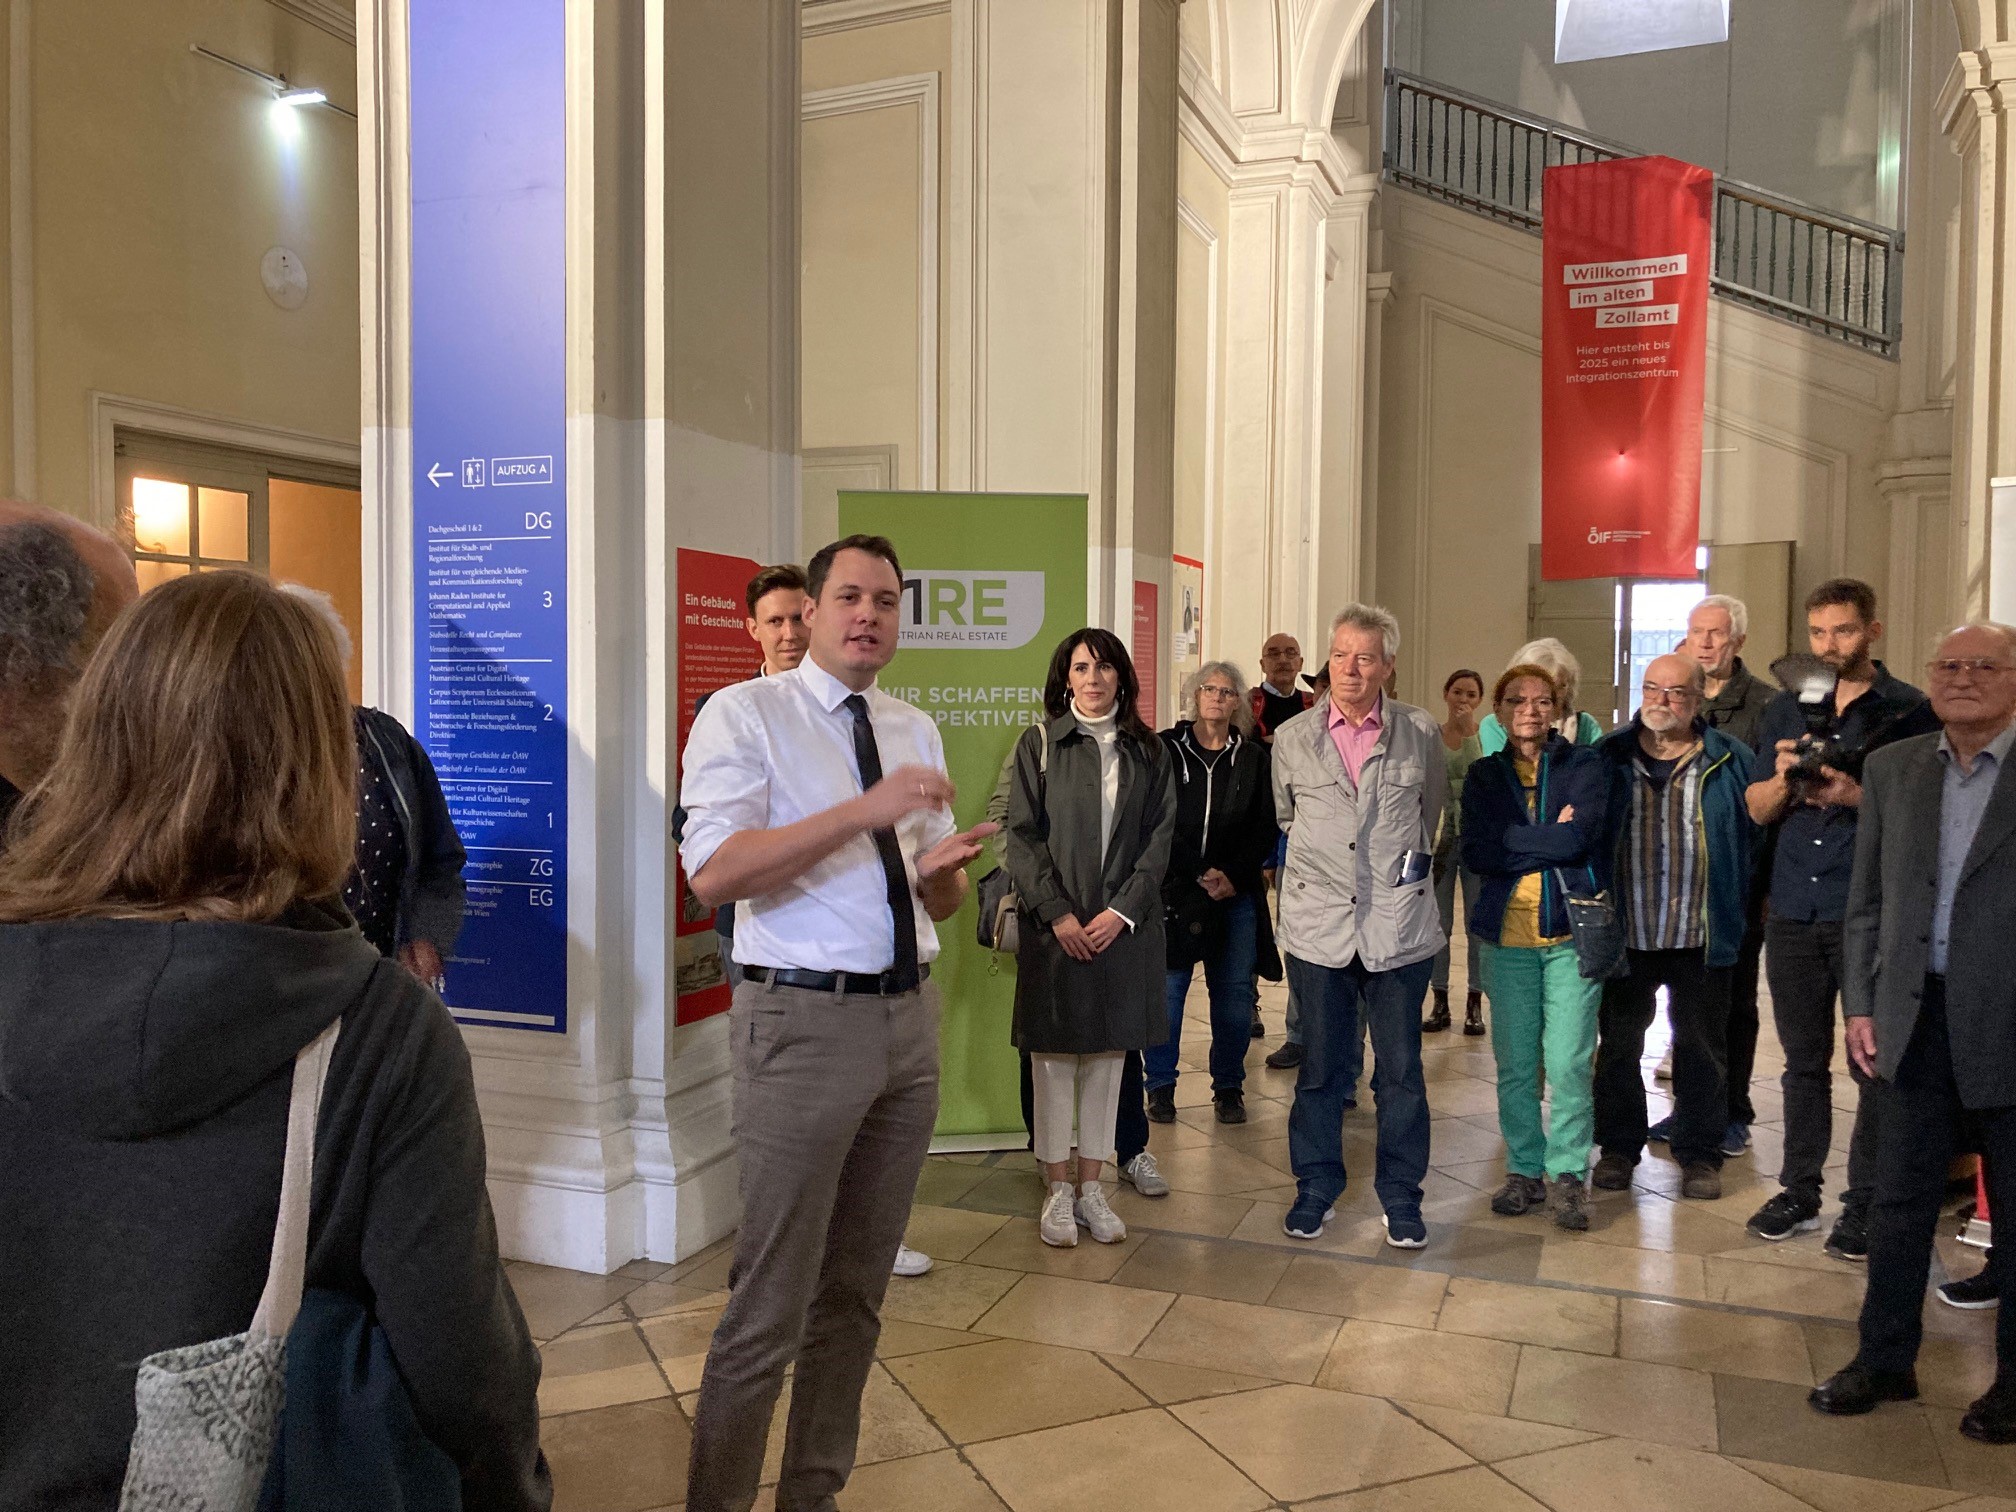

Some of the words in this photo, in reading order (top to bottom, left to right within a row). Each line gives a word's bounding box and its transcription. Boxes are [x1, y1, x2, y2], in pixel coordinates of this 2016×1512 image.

[1572, 260, 1678, 280] Willkommen
[1578, 293, 1598, 304] im
[1604, 288, 1646, 301] alten
[1604, 309, 1670, 324] Zollamt
[1577, 346, 1599, 356] Hier
[1602, 343, 1650, 354] entsteht
[1653, 340, 1670, 350] bis
[1580, 360, 1608, 369] 2025
[1612, 358, 1628, 366] ein
[1632, 356, 1666, 365] neues
[1566, 369, 1678, 384] Integrationszentrum
[497, 465, 536, 476] AUFZUG
[540, 464, 547, 474] A
[525, 511, 552, 530] DG
[429, 554, 483, 563] Regionalforschung
[462, 568, 502, 577] vergleichende
[442, 577, 522, 586] Kommunikationsforschung
[543, 590, 552, 608] 3
[685, 594, 698, 606] Ein
[701, 595, 736, 610] Gebäude
[429, 602, 472, 610] Computational
[486, 602, 510, 610] Applied
[685, 614, 699, 625] mit
[702, 615, 744, 629] Geschichte
[897, 632, 933, 640] TRIAN
[936, 632, 965, 640] REAL
[968, 632, 1008, 640] ESTATE
[487, 665, 508, 674] Digital
[504, 674, 530, 684] Heritage
[430, 689, 450, 698] Corpus
[452, 689, 485, 698] Scriptorum
[928, 687, 1046, 703] SCHAFFEN
[507, 698, 534, 708] Salzburg
[471, 713, 510, 722] Beziehungen
[544, 704, 553, 721] 2
[924, 710, 1046, 726] PEKTIVEN
[501, 752, 510, 760] der
[433, 764, 462, 774] esellschaft
[488, 786, 508, 794] Digital
[504, 796, 530, 805] Heritage
[463, 808, 528, 818] Kulturwissenschaften
[547, 812, 552, 828] 1
[530, 858, 553, 876] ZG
[466, 886, 502, 895] emographie
[530, 888, 553, 906] EG
